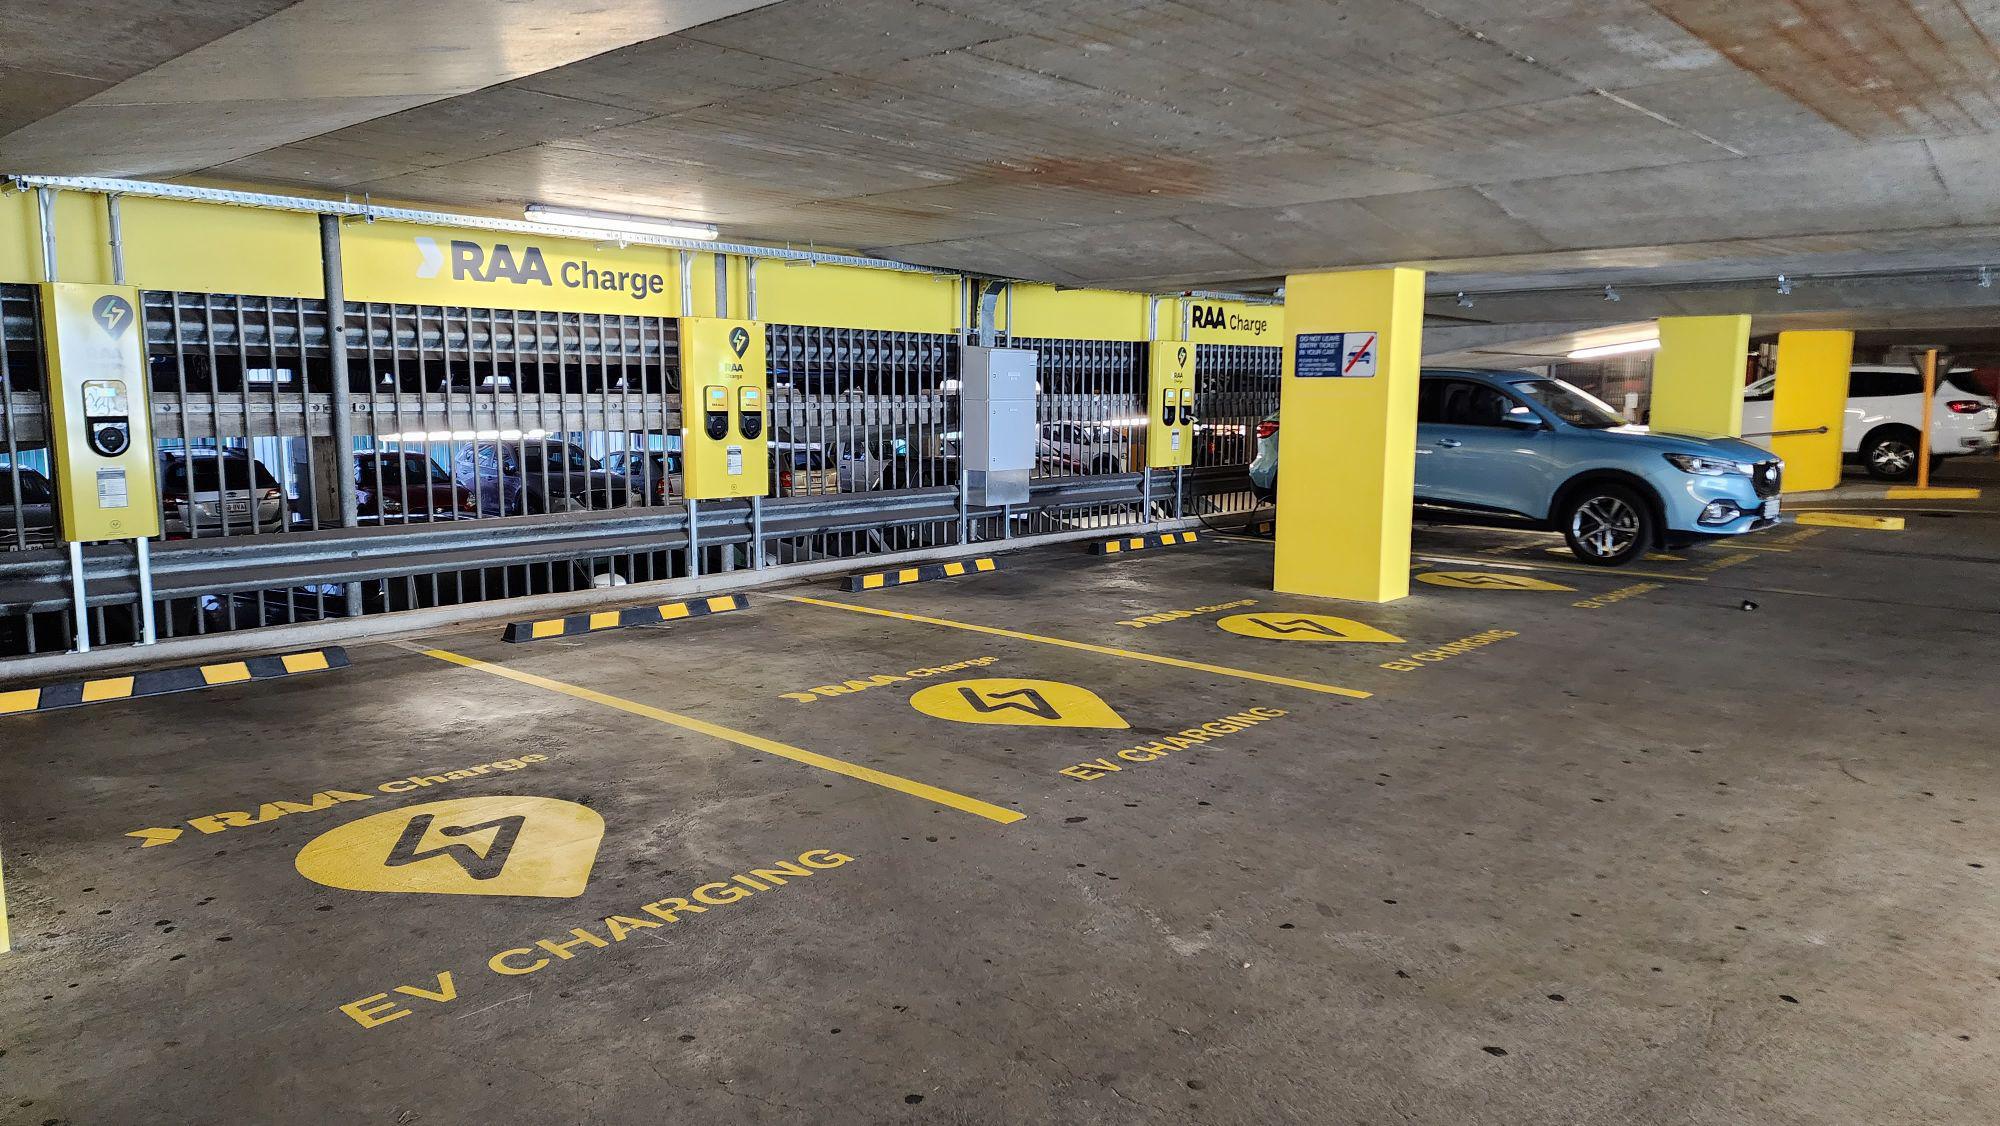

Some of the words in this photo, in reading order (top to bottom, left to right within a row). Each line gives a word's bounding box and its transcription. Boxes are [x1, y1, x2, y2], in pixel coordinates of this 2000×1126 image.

[452, 239, 552, 286] RAA
[561, 260, 664, 299] Charge
[1192, 305, 1226, 329] RAA
[1229, 314, 1267, 336] Charge
[807, 674, 913, 697] RAA
[906, 656, 1000, 677] Charge
[1379, 658, 1426, 672] EV
[1411, 629, 1520, 662] CHARGING
[1058, 757, 1122, 782] EV
[1117, 706, 1289, 764] CHARGING
[187, 789, 375, 836] RAA
[377, 752, 549, 794] Charge
[339, 971, 458, 1030] EV
[488, 848, 855, 976] CHARGING
